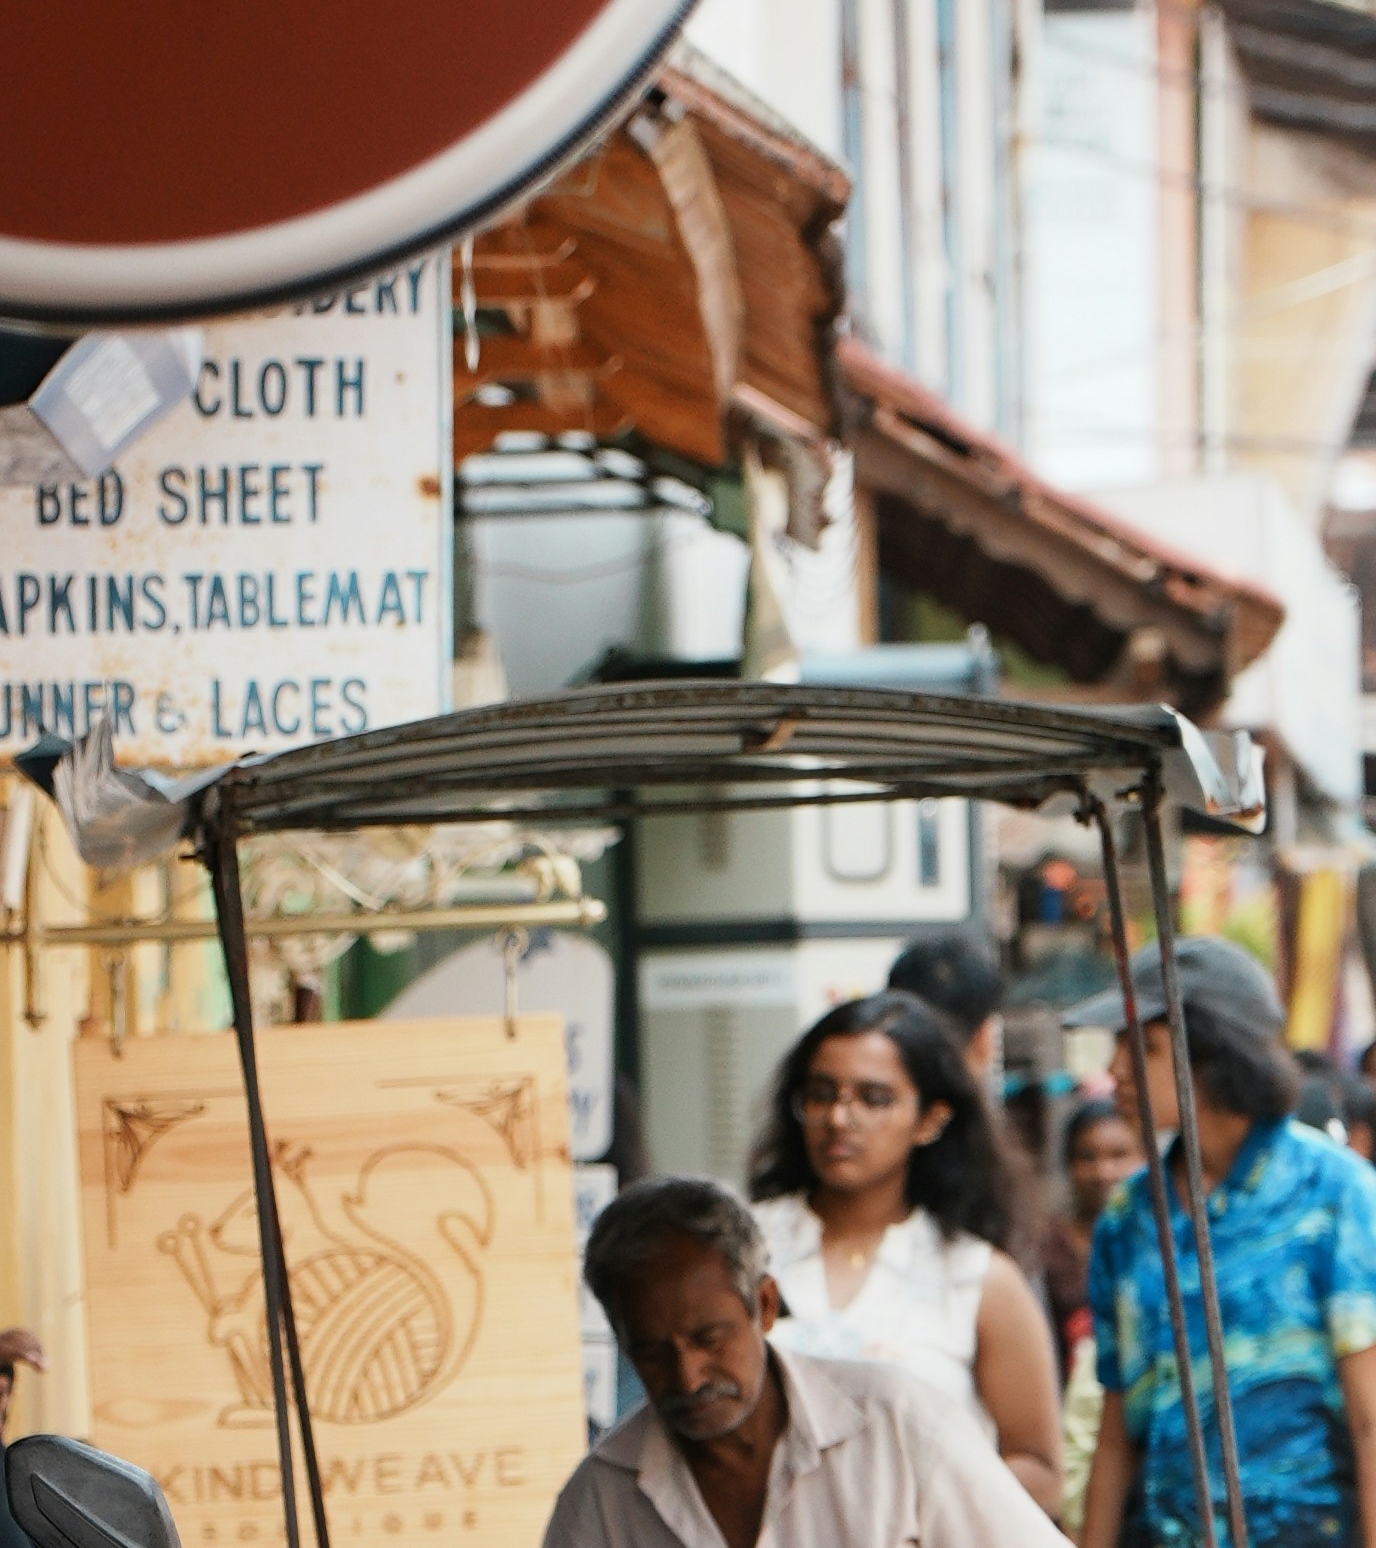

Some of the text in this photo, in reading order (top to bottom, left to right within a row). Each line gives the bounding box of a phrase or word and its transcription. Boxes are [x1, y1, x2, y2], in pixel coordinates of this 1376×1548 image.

[193, 357, 365, 418] CLOTH
[35, 462, 326, 527] BED SHEET
[155, 692, 187, 734] &
[211, 677, 368, 740] LACES
[325, 1447, 524, 1494] WEAVE
